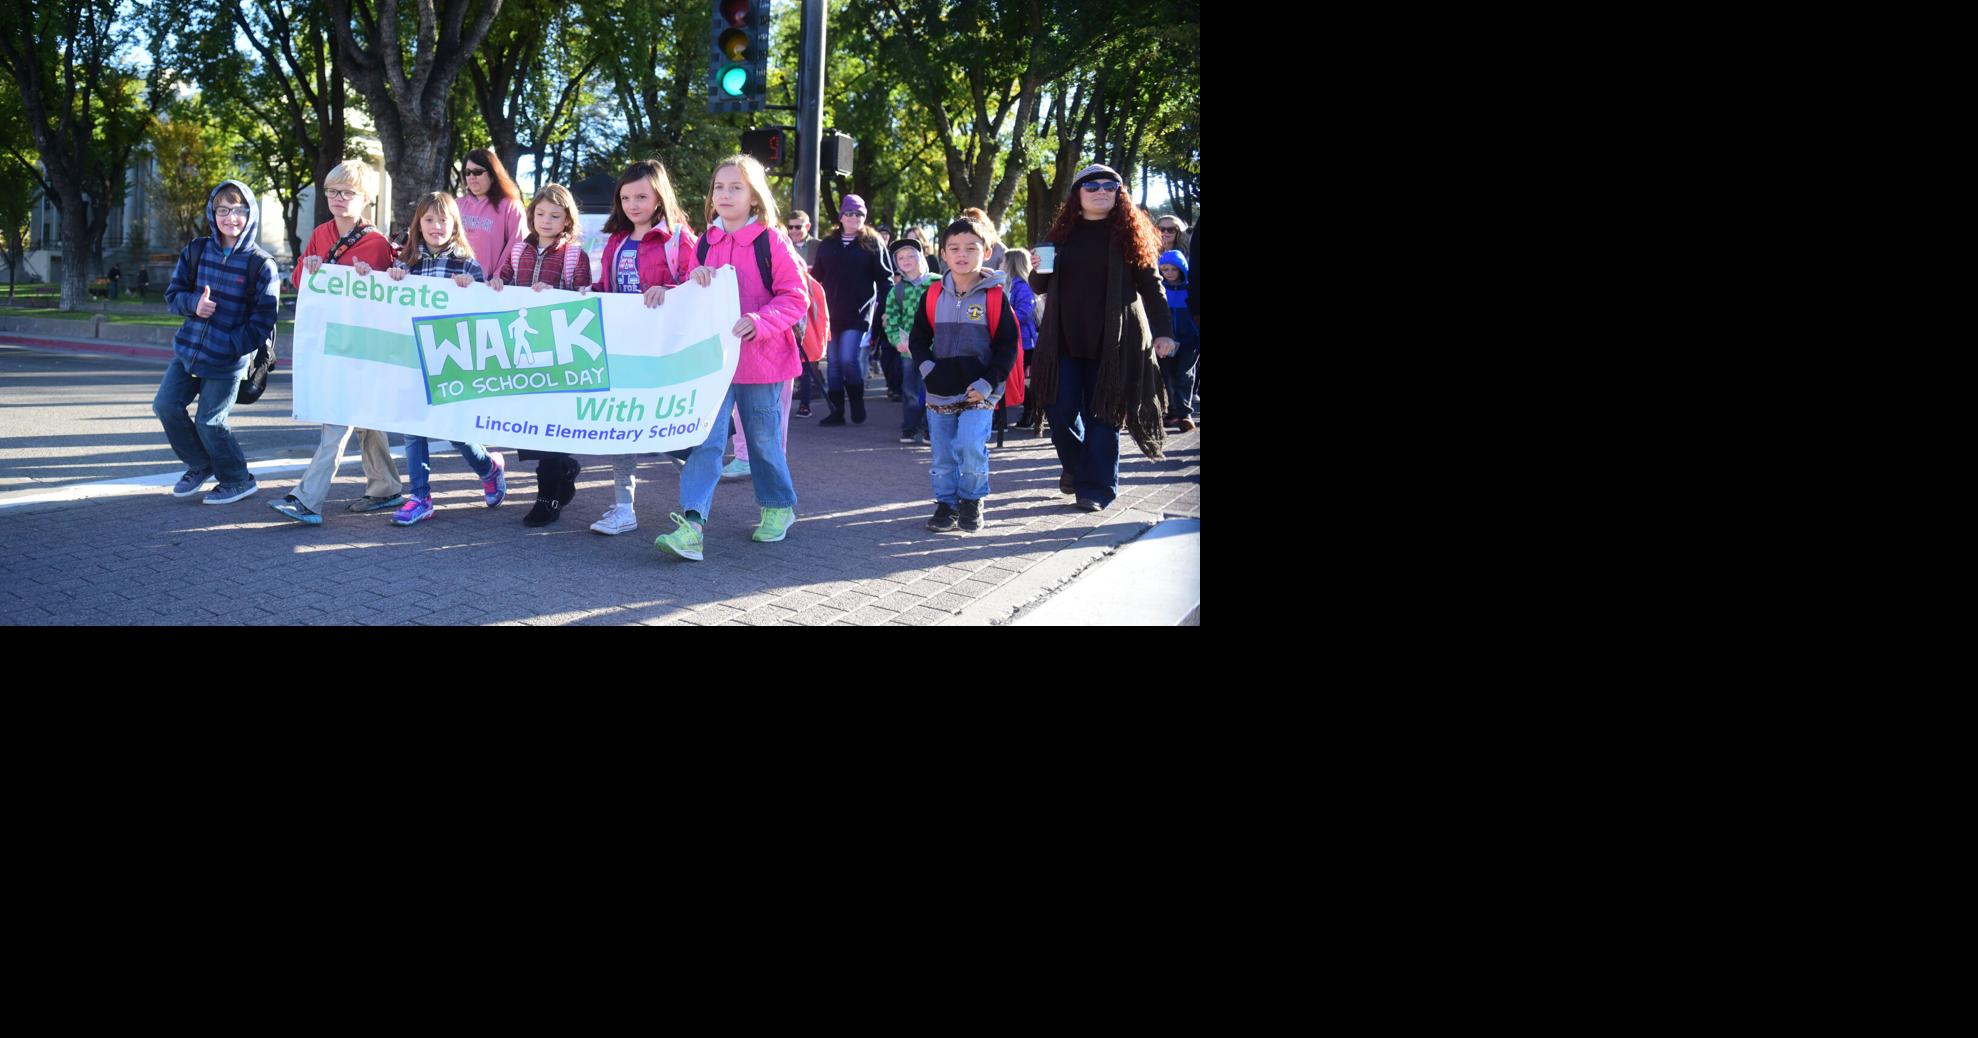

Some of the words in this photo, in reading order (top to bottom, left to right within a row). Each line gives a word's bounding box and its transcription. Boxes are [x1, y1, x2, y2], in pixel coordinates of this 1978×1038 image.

[307, 269, 449, 310] Celebrate
[418, 308, 603, 377] WALK
[437, 380, 464, 398] TO
[472, 372, 558, 394] SCHOOL
[565, 367, 604, 386] DAY
[576, 396, 645, 422] With
[655, 389, 697, 419] Us!
[475, 415, 539, 435] Lincoln
[545, 424, 643, 442] Elementary
[648, 418, 700, 438] School
